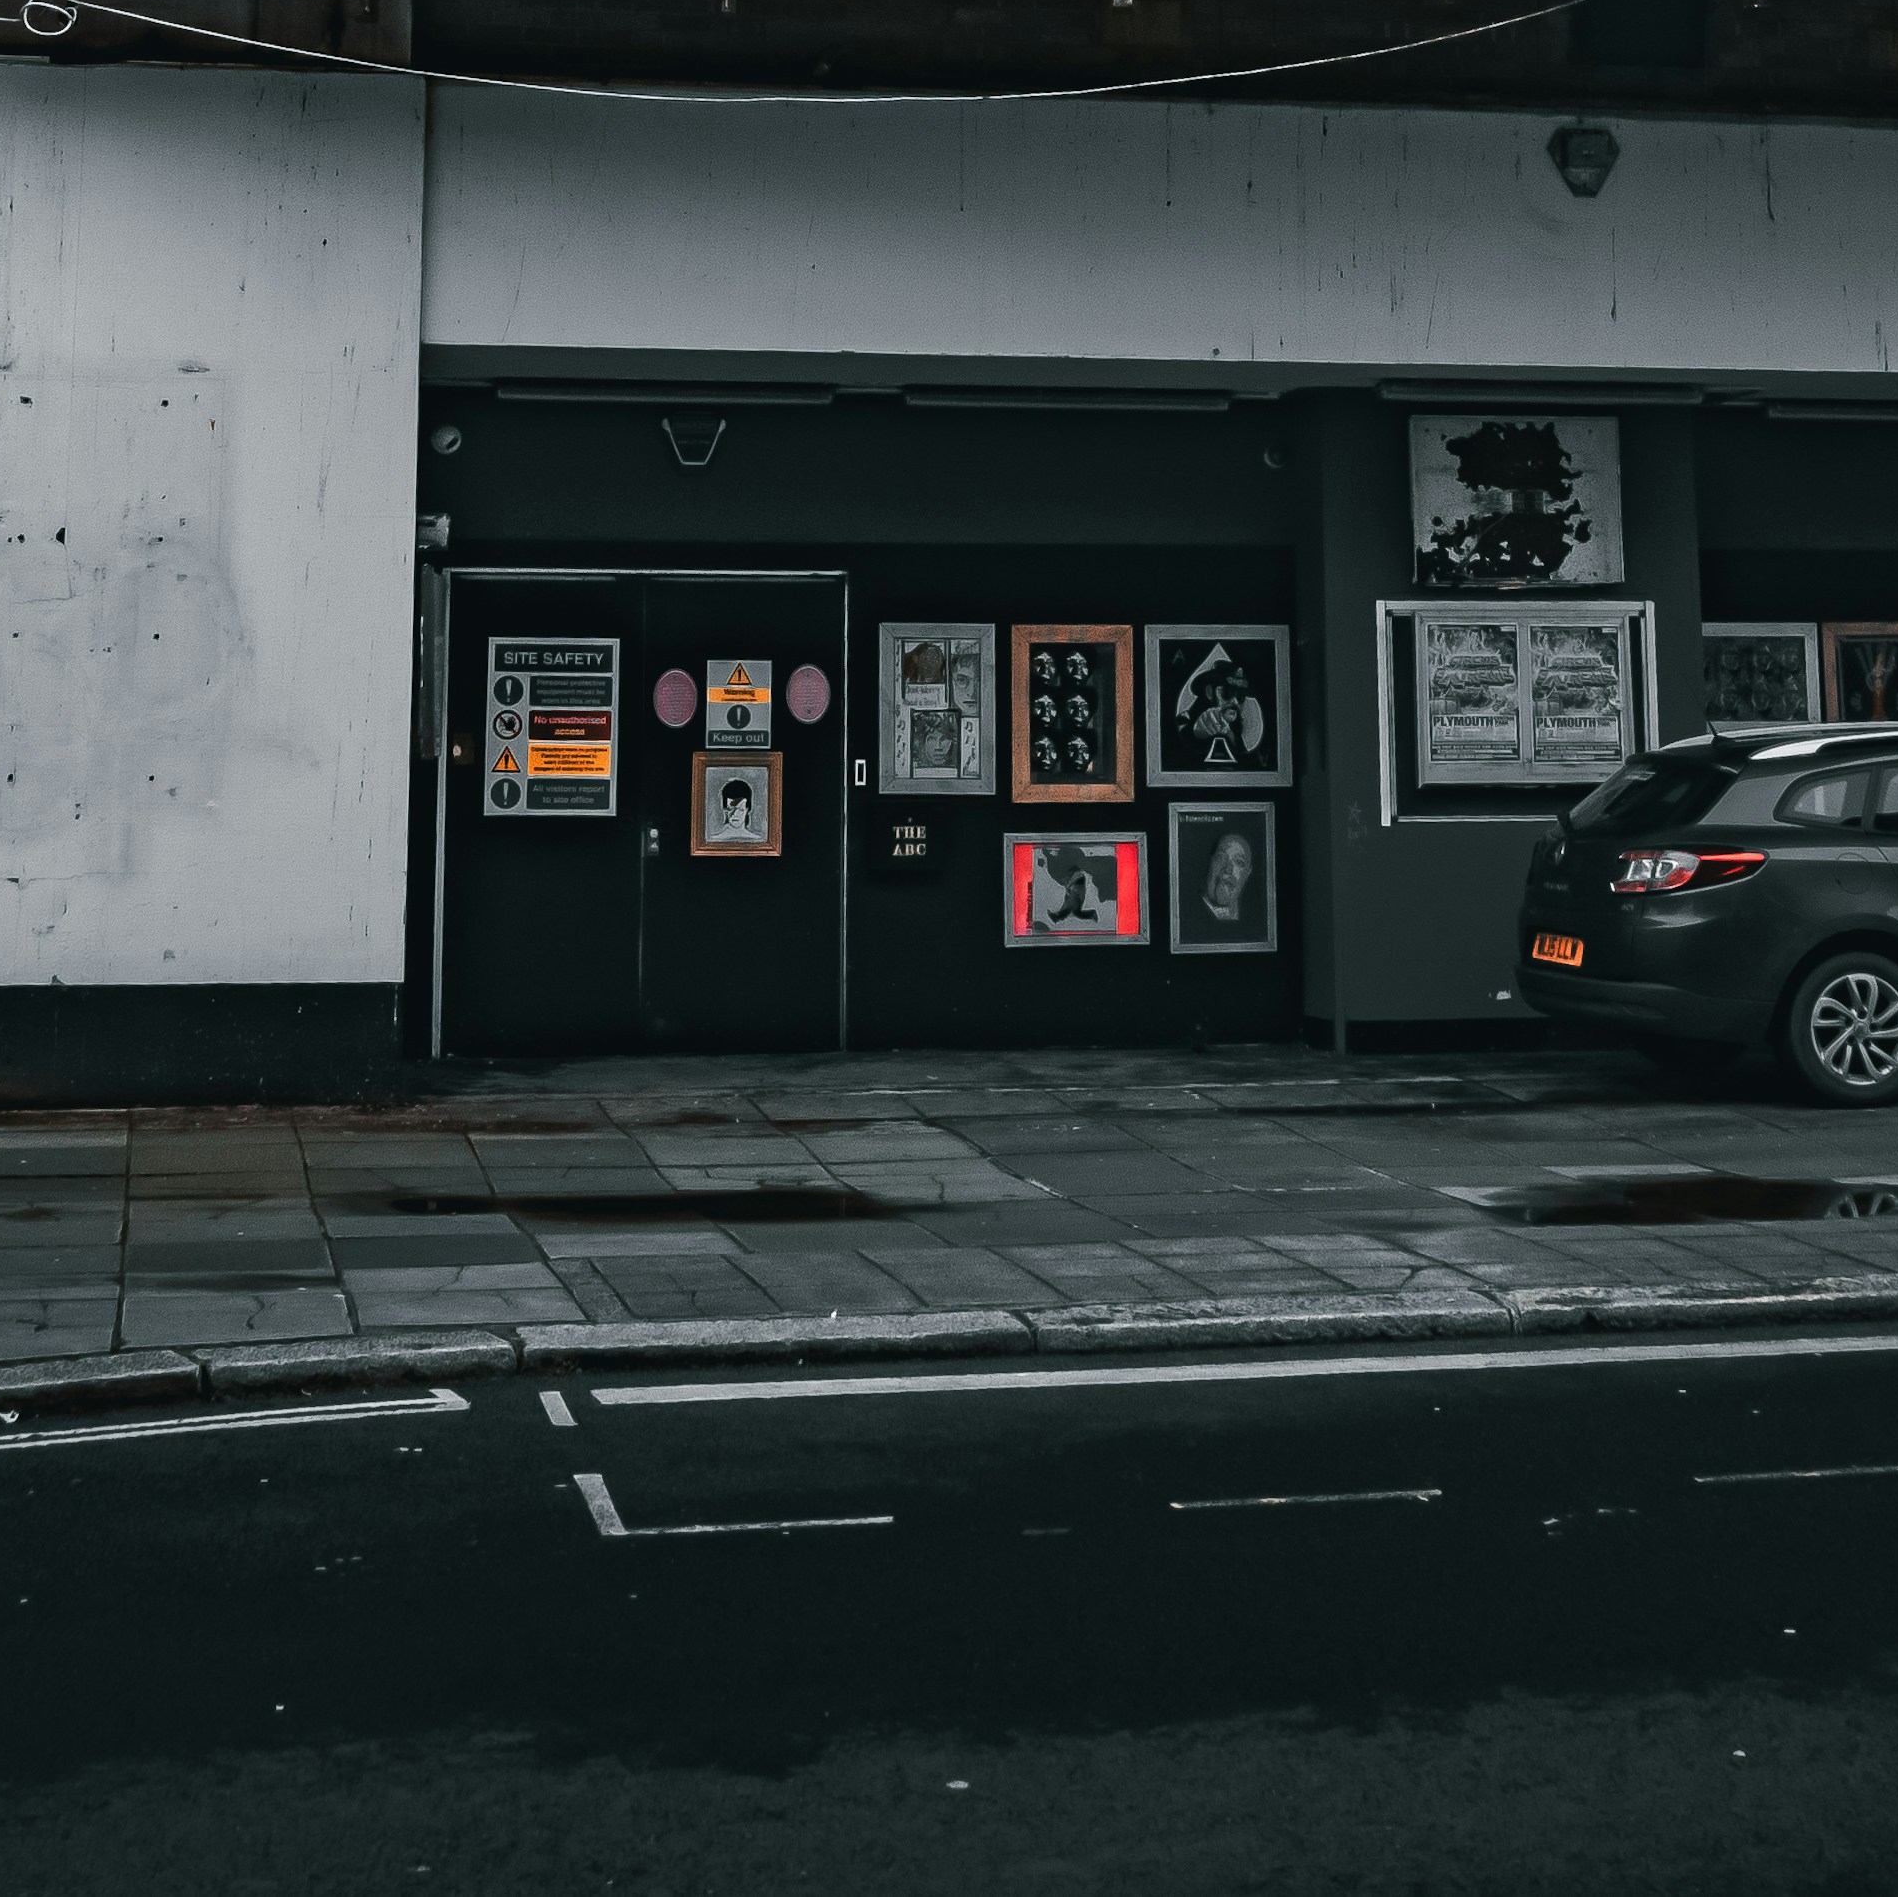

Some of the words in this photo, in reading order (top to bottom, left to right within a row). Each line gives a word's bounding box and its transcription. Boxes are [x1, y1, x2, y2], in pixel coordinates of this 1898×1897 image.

[504, 652, 538, 665] SITE
[543, 652, 604, 666] SAFETY
[1433, 716, 1494, 727] PLYMOUTH
[1536, 717, 1597, 728] PLYMOUTH
[713, 733, 742, 744] Keep
[746, 732, 764, 743] out
[892, 825, 927, 839] THE
[892, 843, 927, 857] ABC
